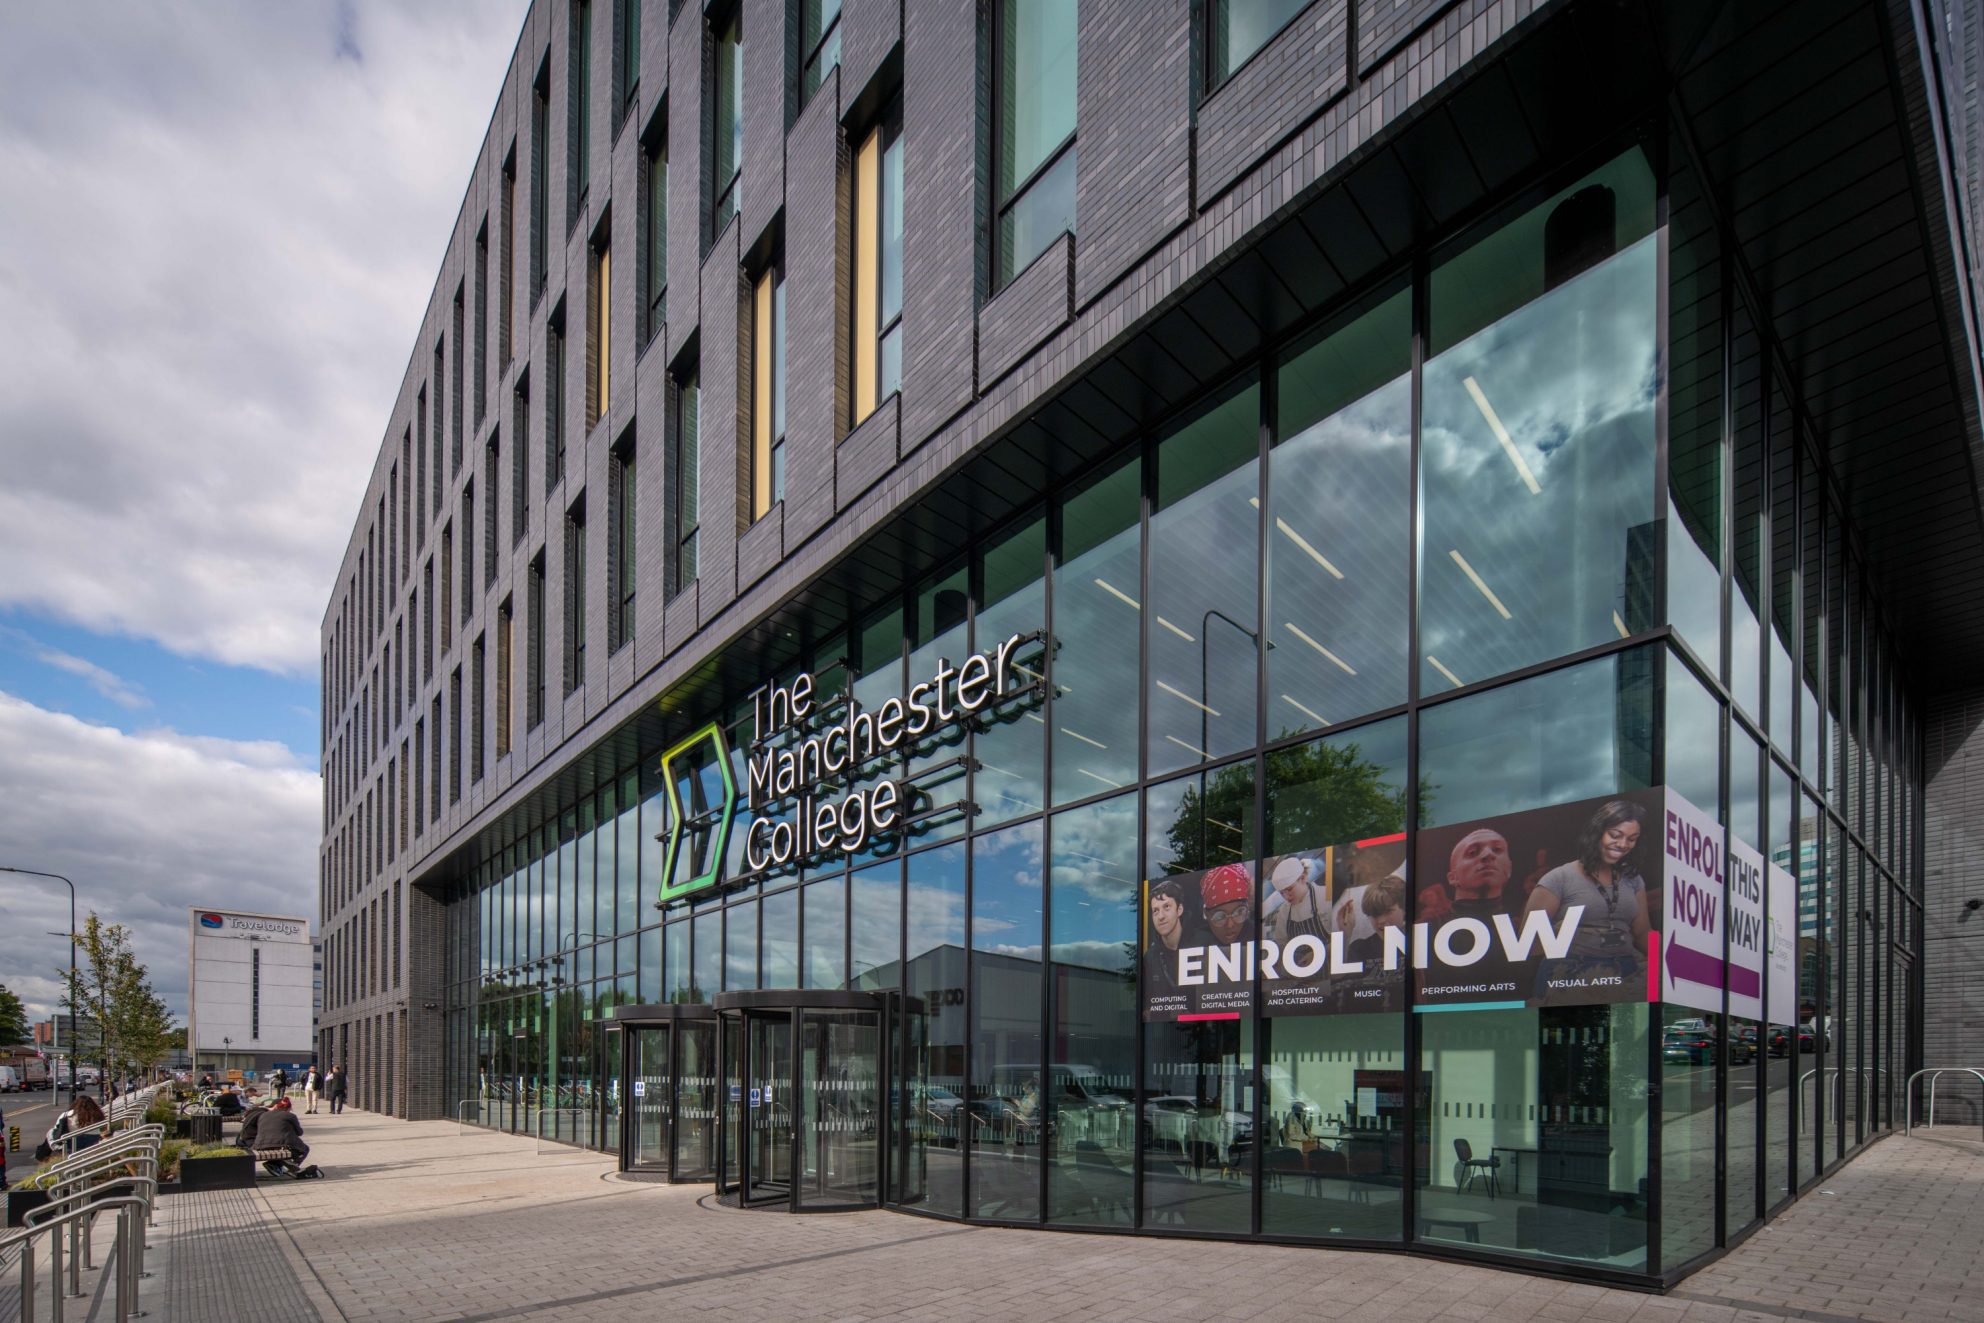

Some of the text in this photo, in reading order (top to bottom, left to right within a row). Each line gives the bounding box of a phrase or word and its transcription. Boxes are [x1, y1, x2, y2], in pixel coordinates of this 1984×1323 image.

[747, 672, 815, 741] The
[748, 633, 1024, 809] Manchester
[747, 780, 901, 871] College
[1666, 809, 1722, 884] ENROL
[1729, 852, 1759, 904] THIS
[1673, 875, 1717, 934] NOW
[228, 917, 299, 935] Travelodge
[1729, 904, 1760, 952] WAY
[1178, 905, 1586, 986] ENROL NOW
[1271, 987, 1320, 996] HOSPITALITY
[1422, 982, 1516, 995] PERFORMING ARTS
[1547, 976, 1623, 989] VISUAL ARTS
[1150, 995, 1187, 1004] COMPUTING
[1201, 992, 1233, 1000] CREATIVE
[1267, 996, 1324, 1006] AND CATERING
[1354, 989, 1382, 998] MUSIC
[1227, 1000, 1250, 1008] MEDIA
